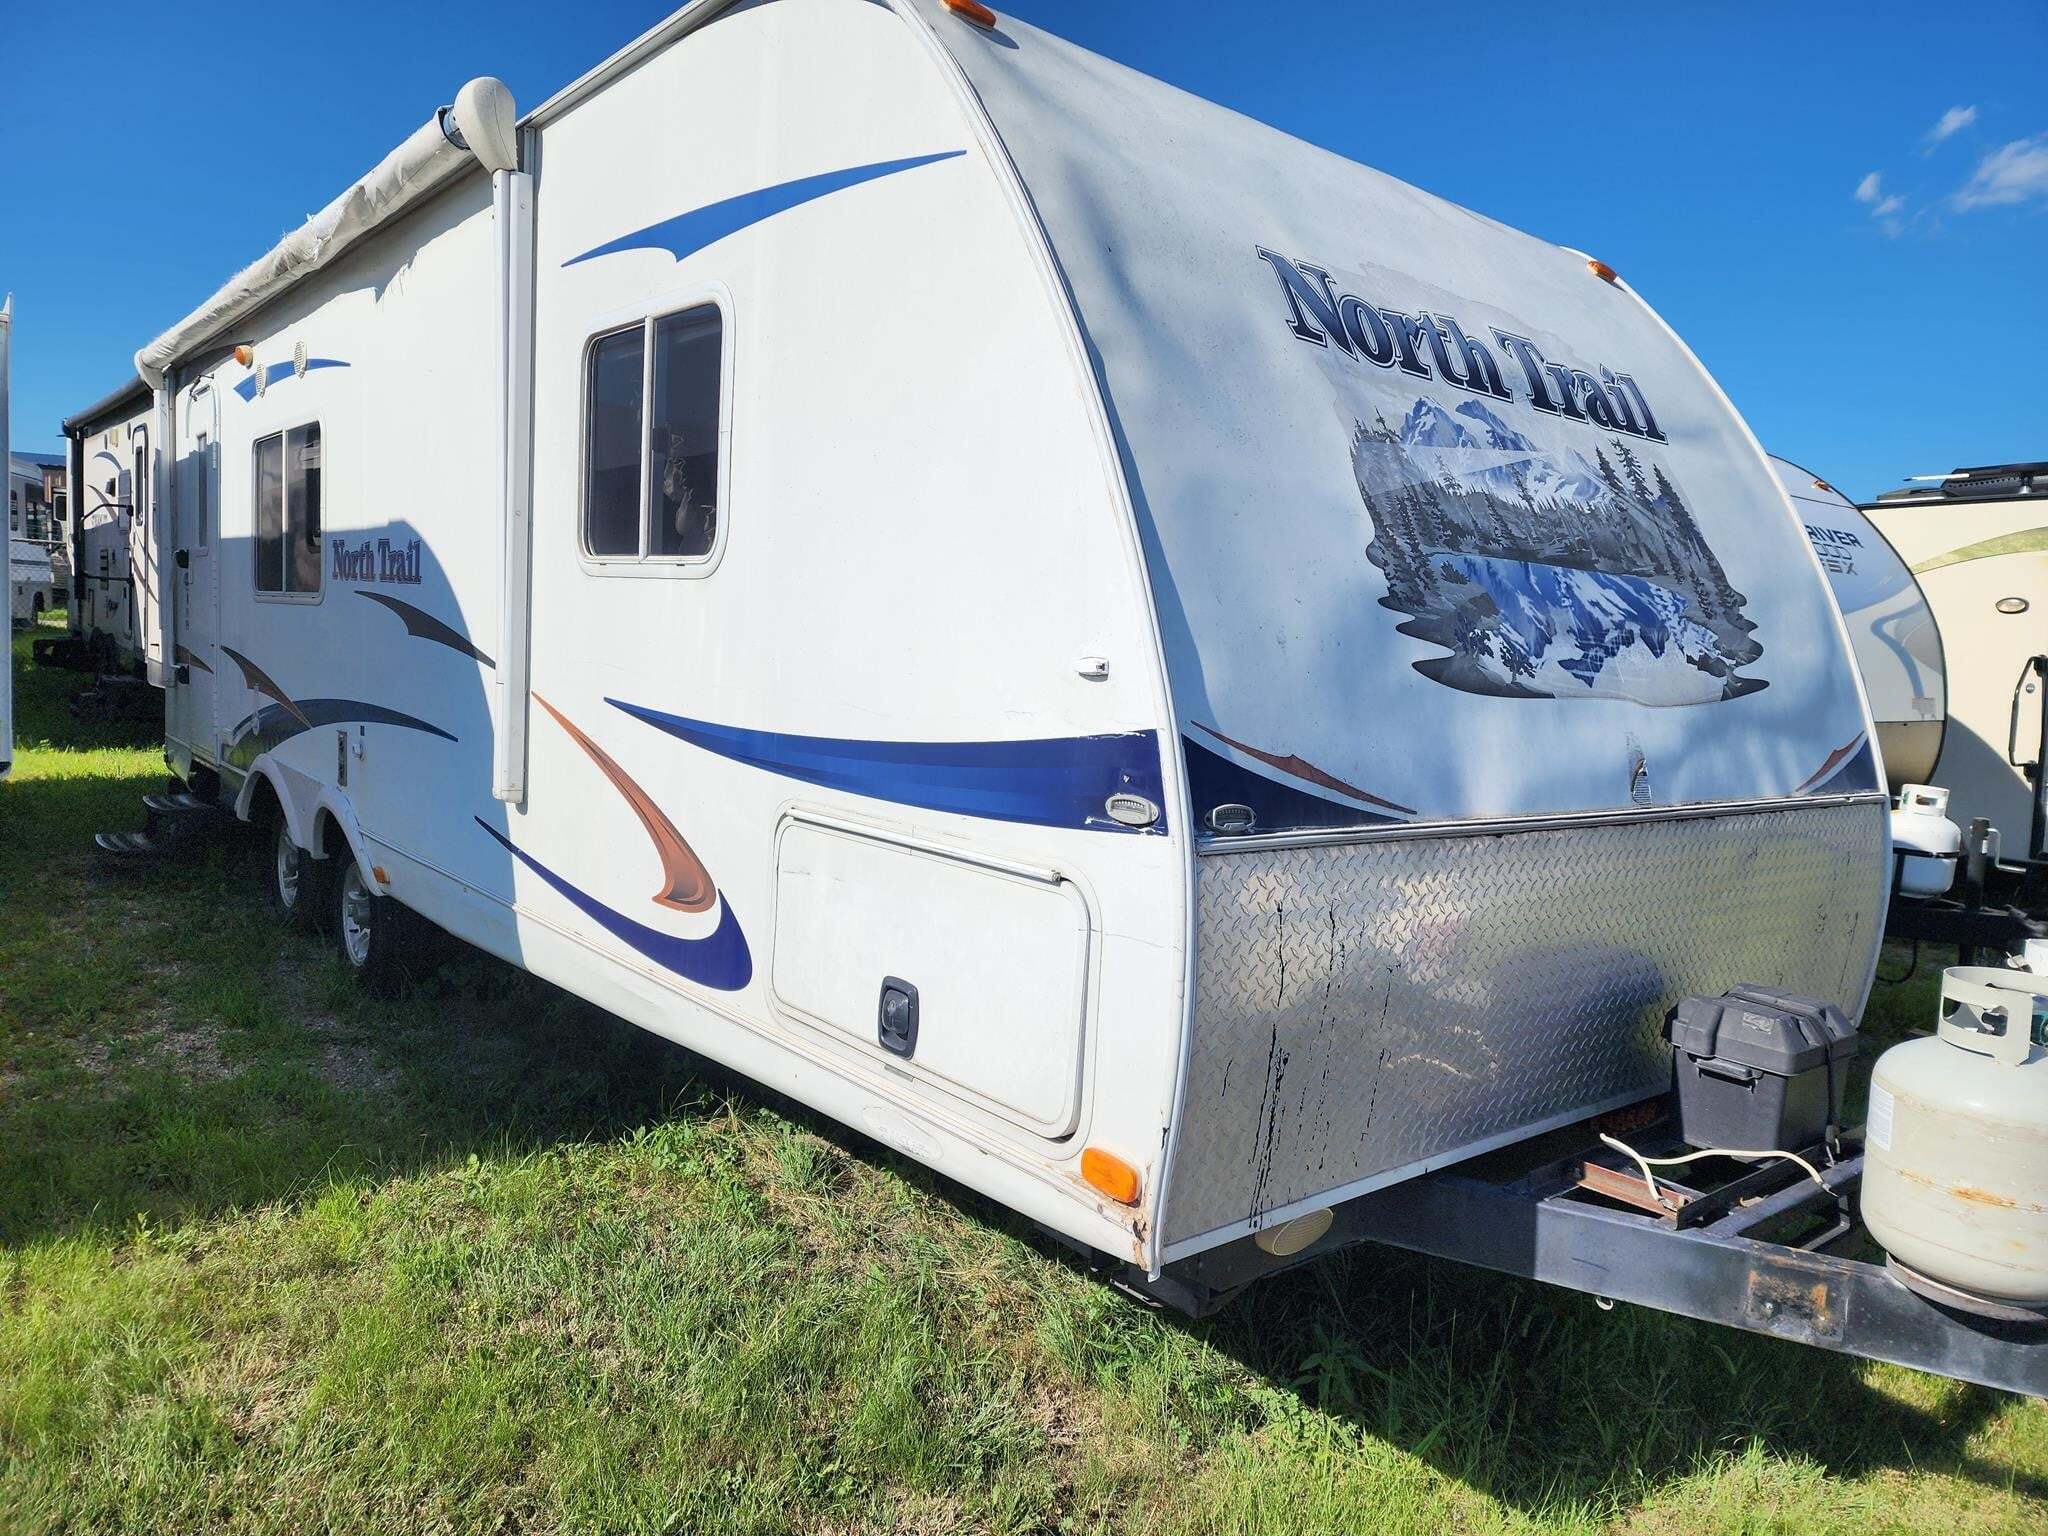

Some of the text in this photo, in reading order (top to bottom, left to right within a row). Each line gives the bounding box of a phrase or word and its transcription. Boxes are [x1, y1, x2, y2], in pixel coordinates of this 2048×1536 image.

[1255, 245, 1669, 445] North Trail
[1804, 524, 1864, 549] RIVER
[331, 537, 422, 584] North Trail
